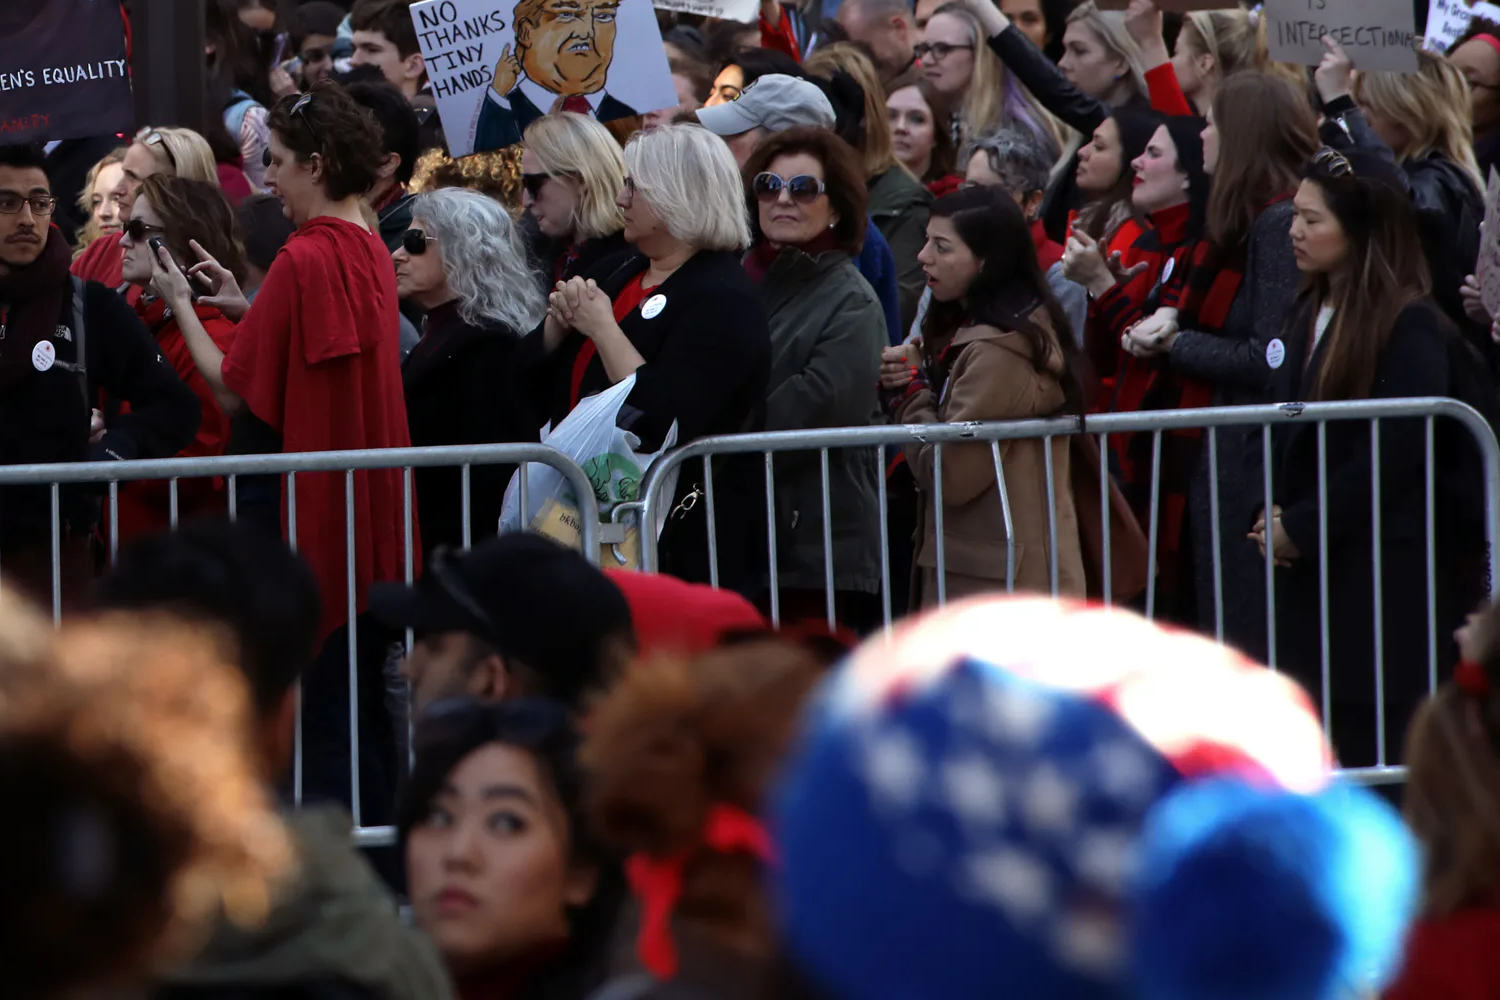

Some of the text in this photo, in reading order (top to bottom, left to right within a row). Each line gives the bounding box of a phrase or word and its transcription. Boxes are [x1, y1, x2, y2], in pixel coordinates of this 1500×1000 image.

[419, 0, 457, 29] NO
[419, 10, 506, 50] THANKS
[43, 59, 126, 86] EQUALITY
[425, 43, 483, 73] TINY
[433, 64, 493, 99] HANDS
